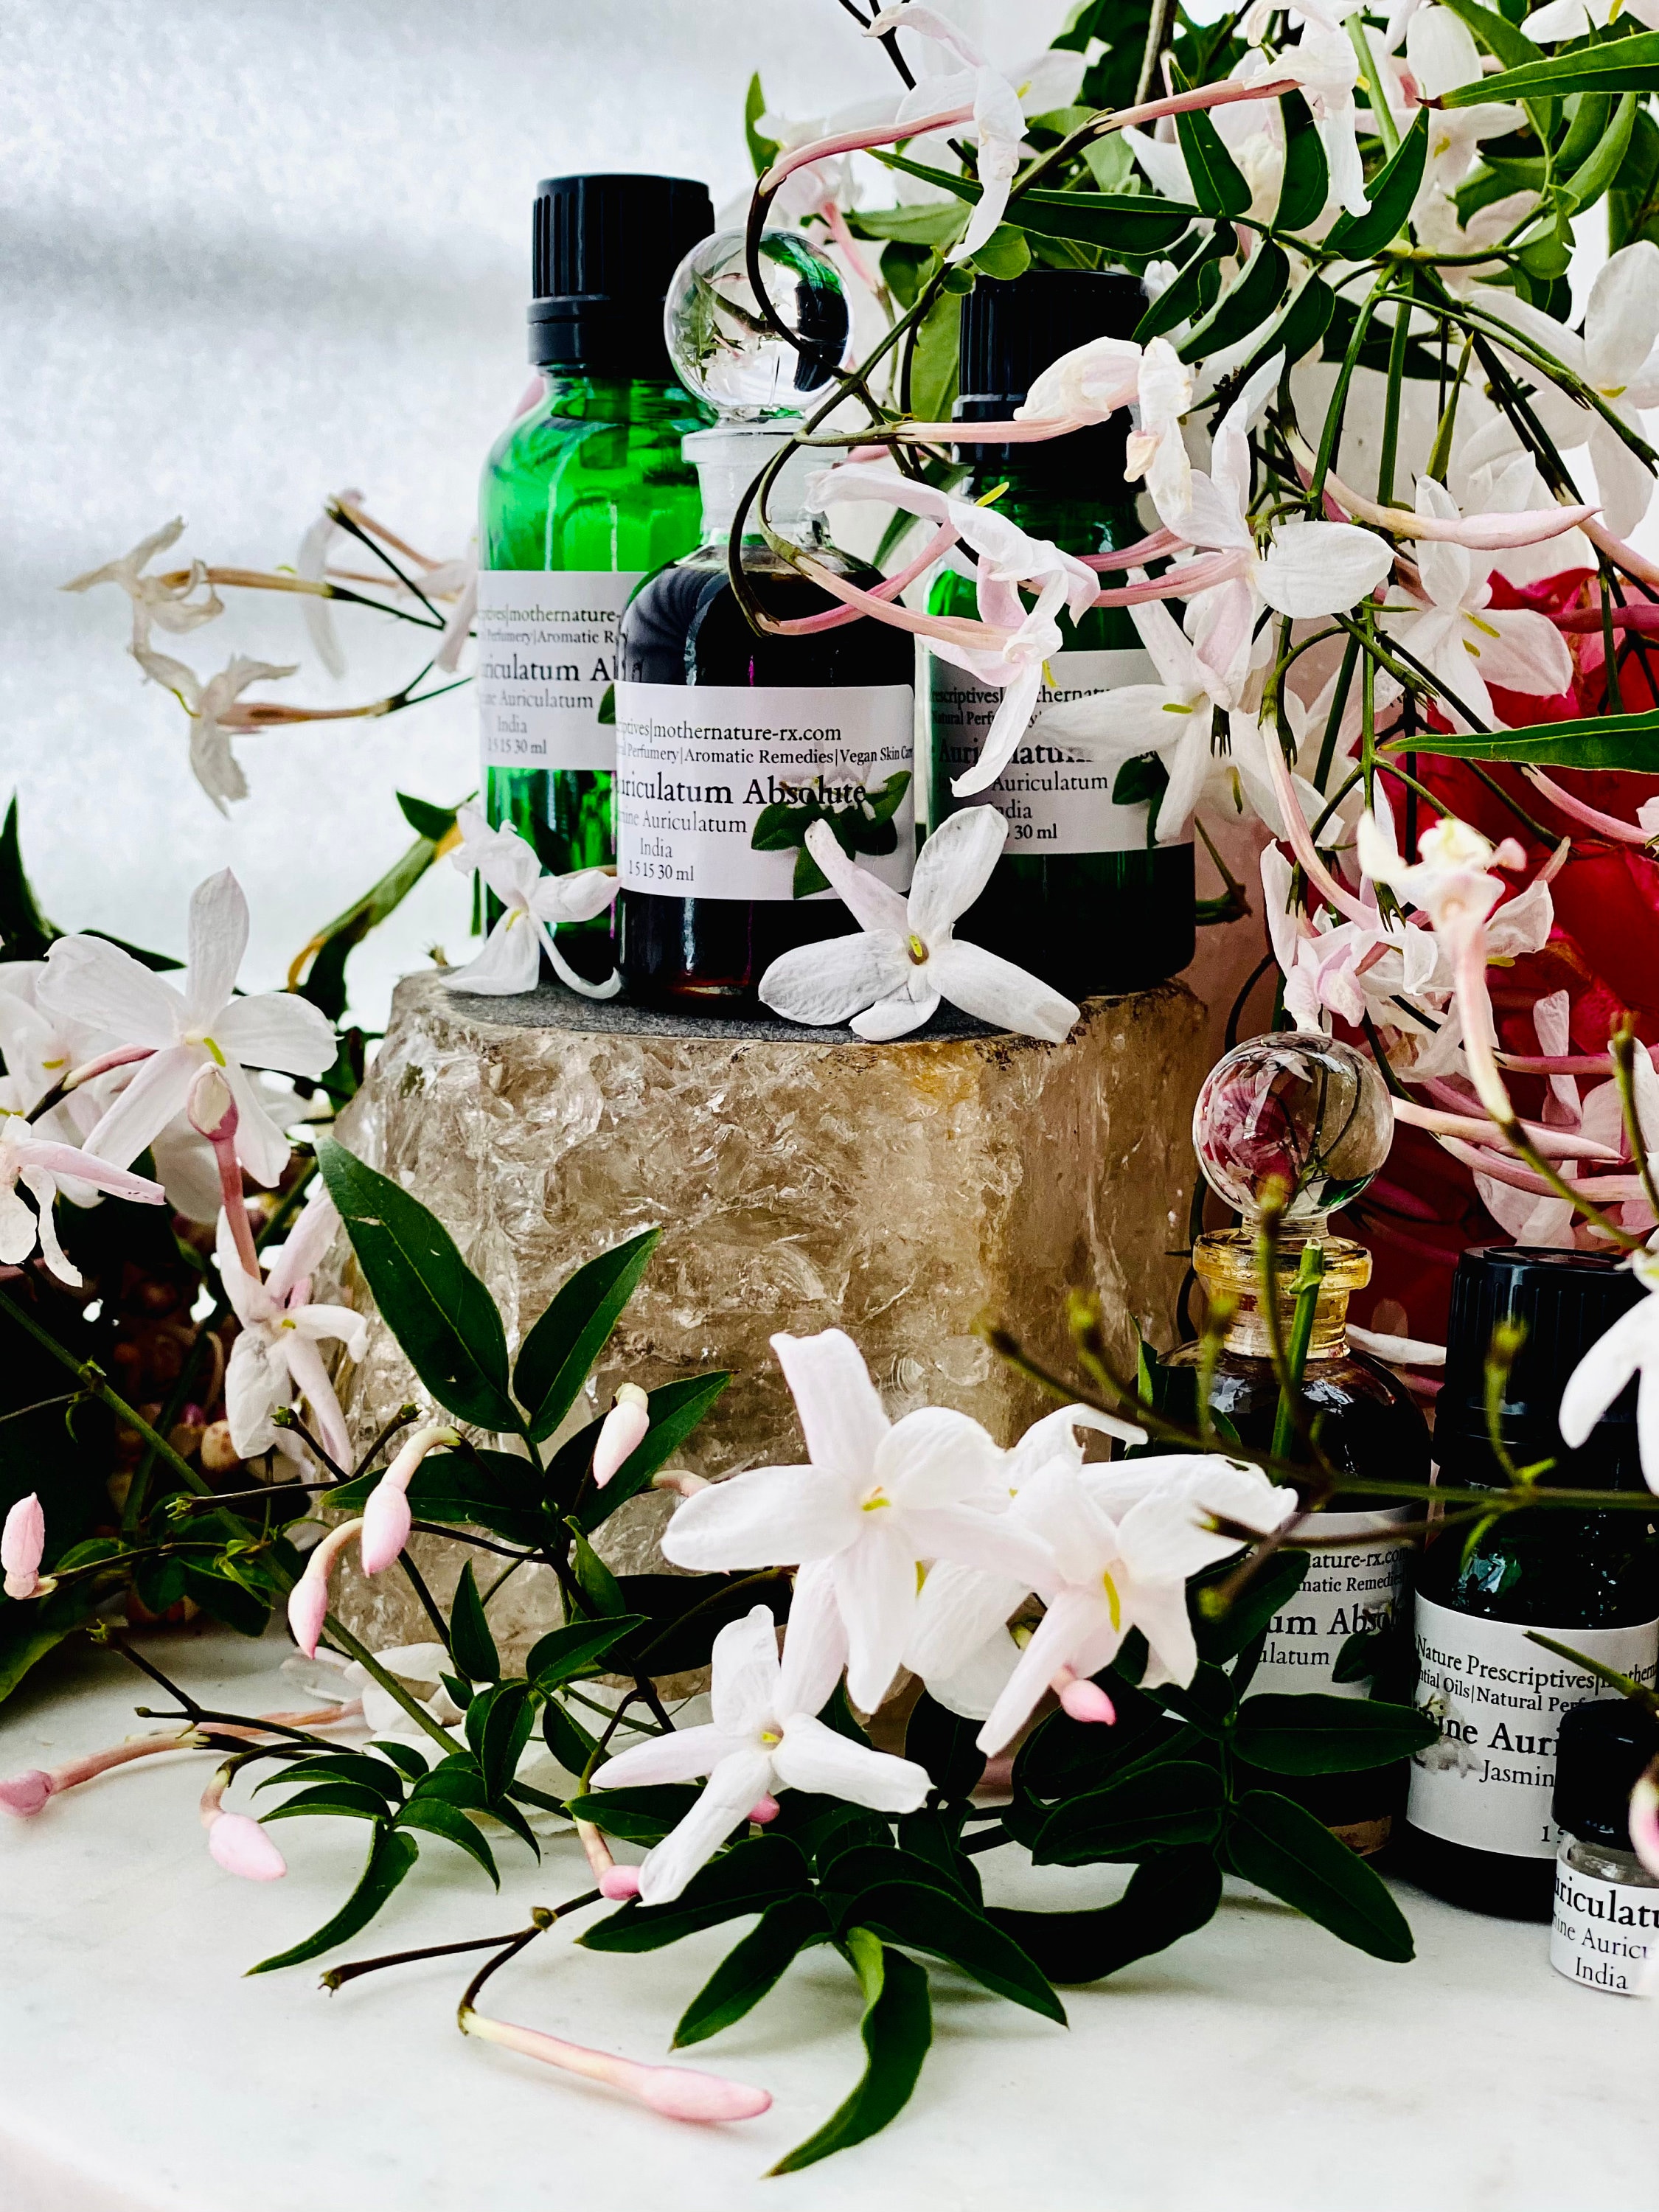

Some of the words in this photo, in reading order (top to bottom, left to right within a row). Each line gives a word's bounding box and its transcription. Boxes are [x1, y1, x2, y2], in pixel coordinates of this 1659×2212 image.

[498, 713, 527, 733] India
[530, 739, 547, 754] ml
[880, 745, 900, 761] Skin
[742, 774, 866, 804] Absolute
[991, 771, 1107, 791] Auriculatum
[642, 809, 748, 833] Auriculatum
[1015, 824, 1032, 840] 30
[1037, 823, 1057, 839] ml
[639, 836, 674, 858] India
[658, 864, 673, 880] 30
[676, 866, 694, 881] ml
[1417, 1634, 1462, 1671] Nature
[1575, 1955, 1629, 1989] India
